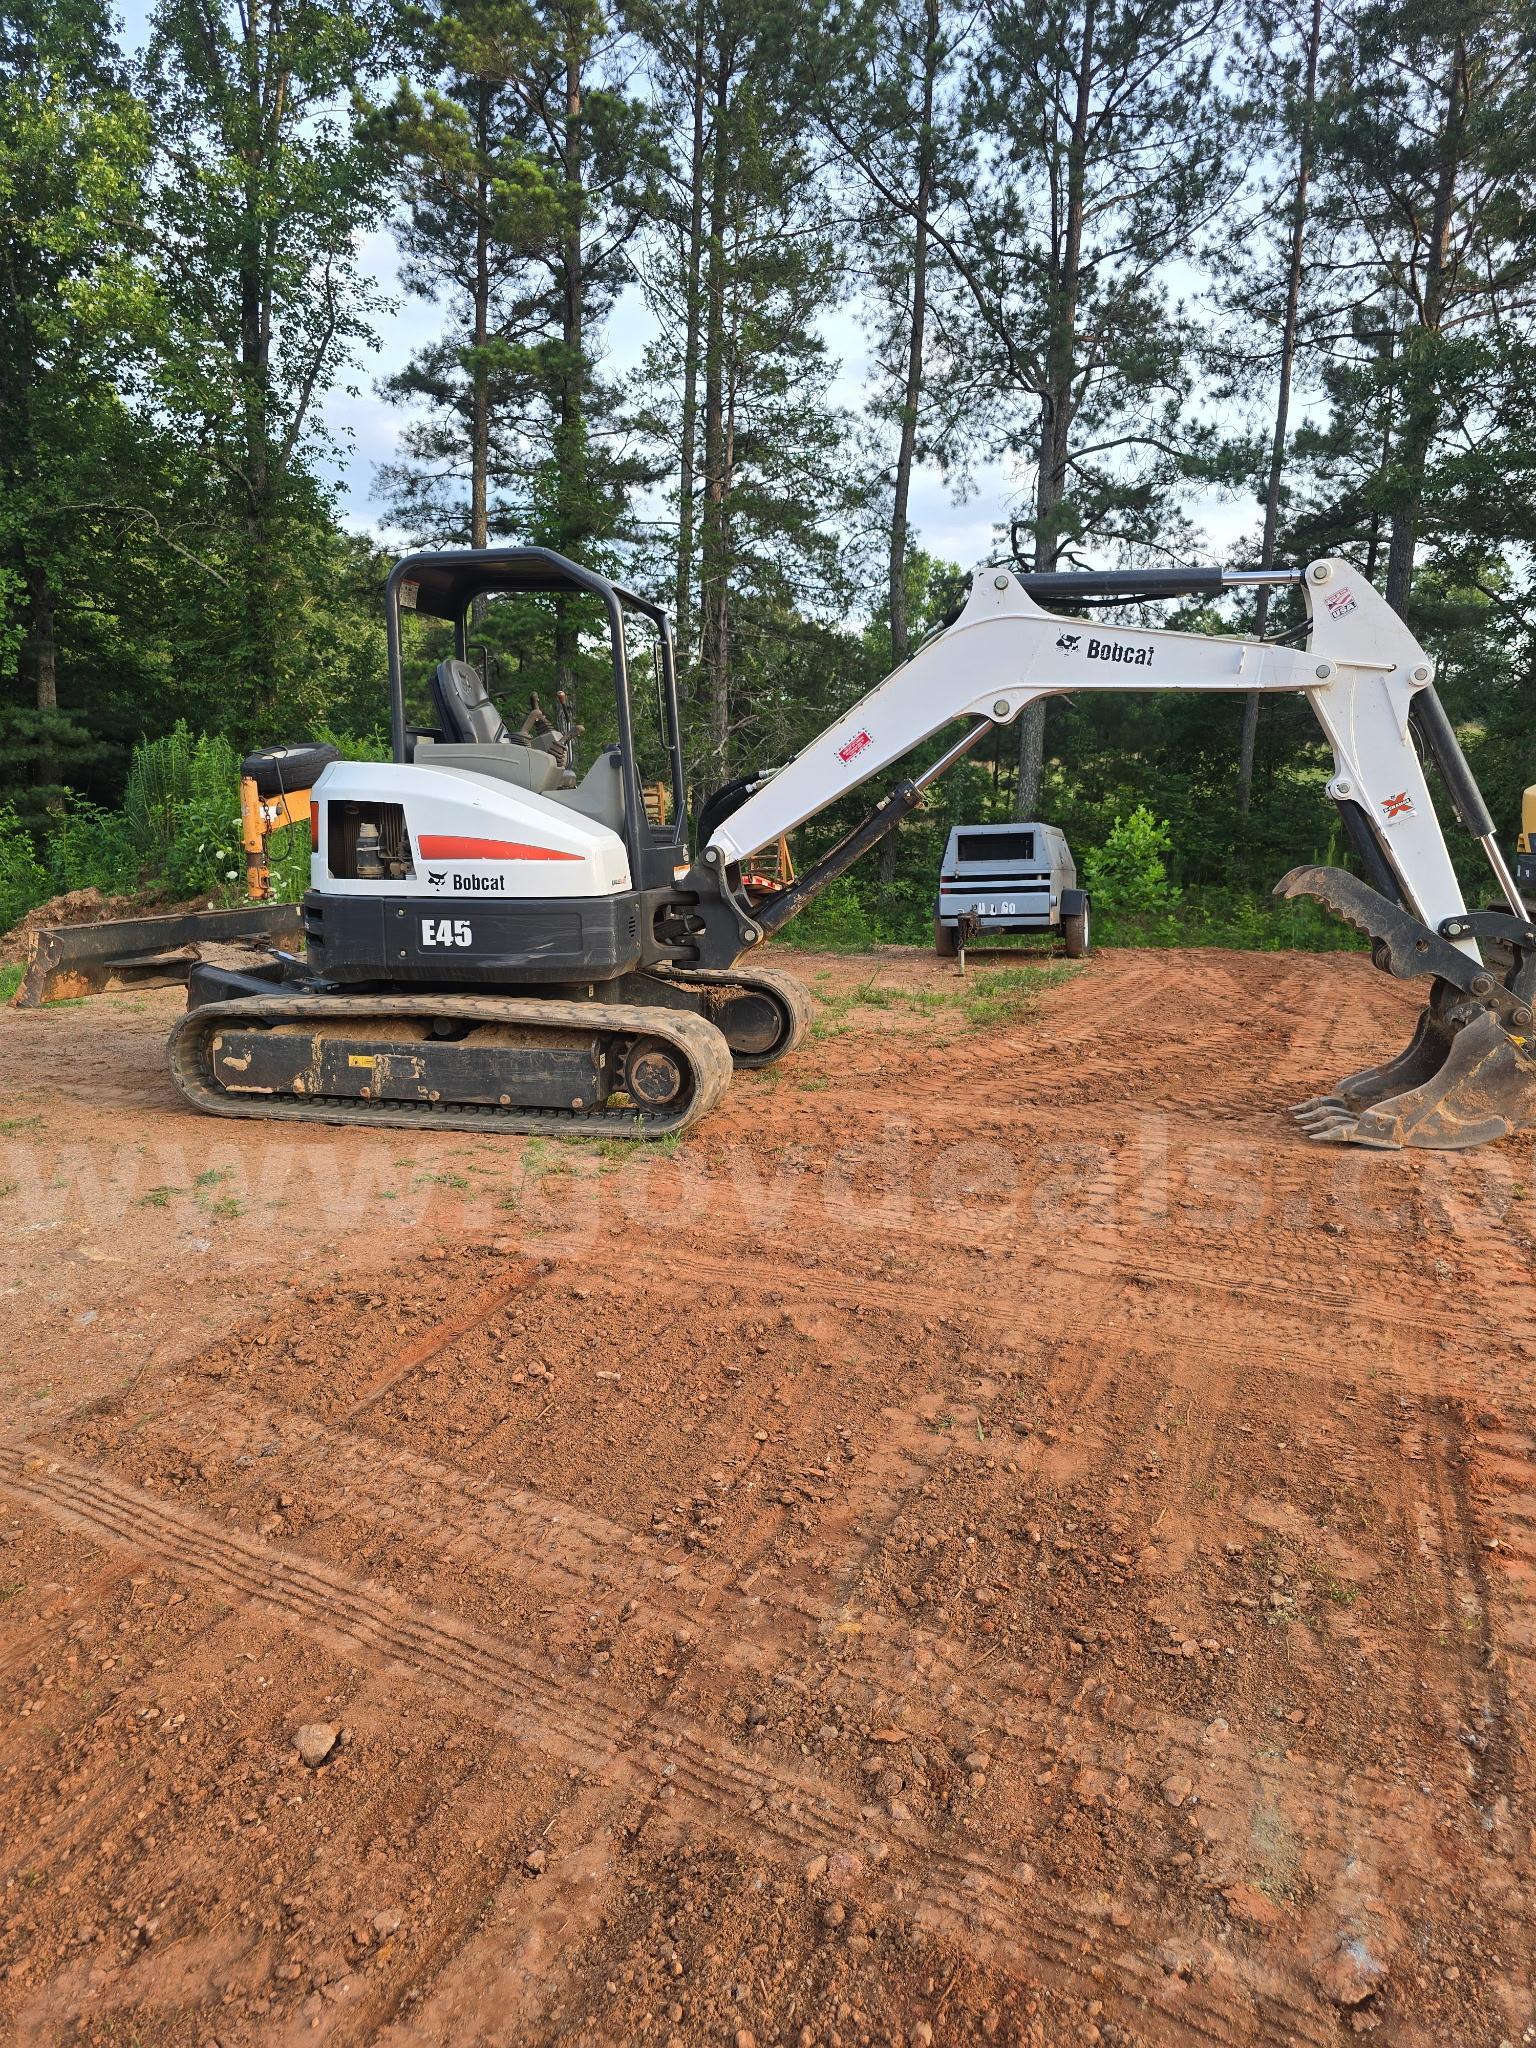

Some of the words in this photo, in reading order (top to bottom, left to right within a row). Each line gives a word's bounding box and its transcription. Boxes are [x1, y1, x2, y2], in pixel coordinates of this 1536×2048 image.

[1086, 638, 1155, 667] Bobcat
[453, 874, 505, 891] Bobcat
[421, 919, 473, 947] E45
